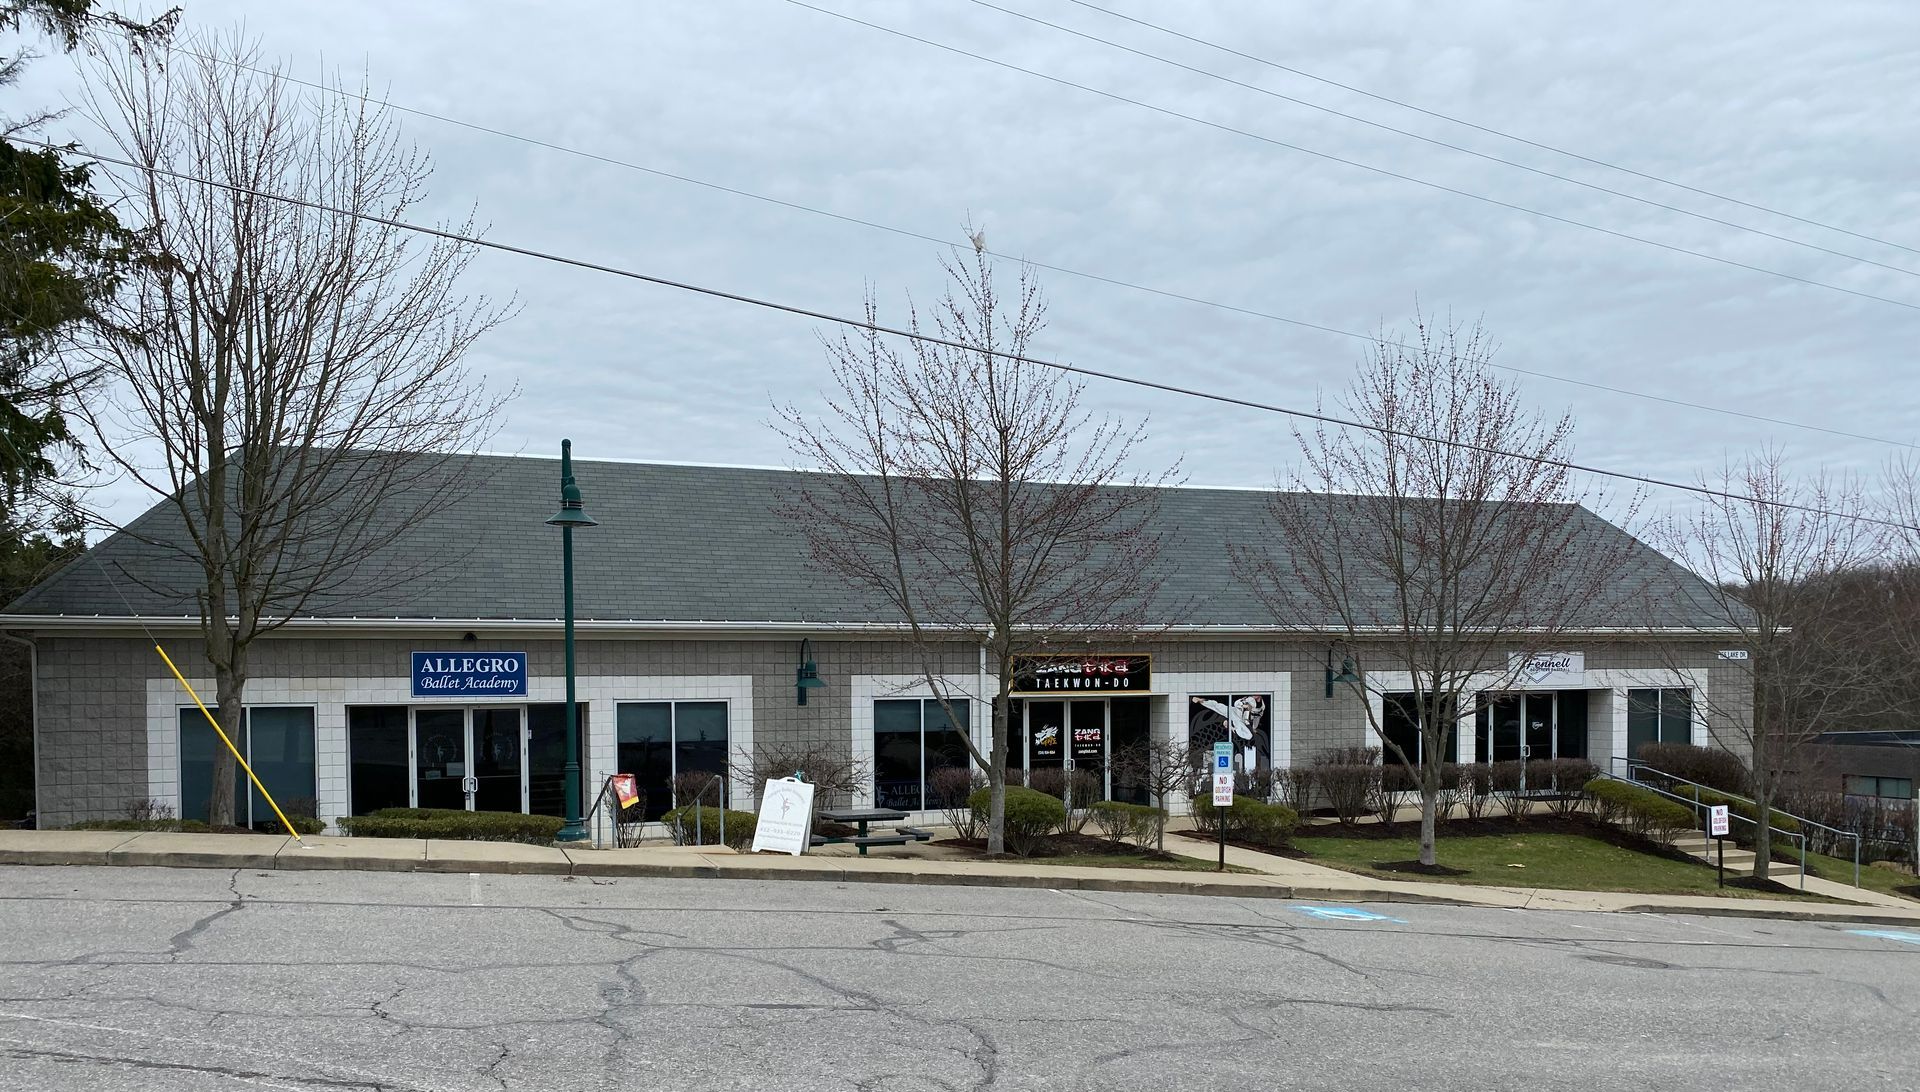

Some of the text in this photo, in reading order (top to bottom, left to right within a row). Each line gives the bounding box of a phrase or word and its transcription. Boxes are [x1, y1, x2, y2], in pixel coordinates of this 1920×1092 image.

[421, 658, 519, 673] ALLEGRO
[1526, 657, 1571, 669] Fennell
[421, 675, 519, 692] Ballet Academy
[1036, 678, 1129, 689] TAEKWON-DO
[1219, 776, 1228, 784] NO
